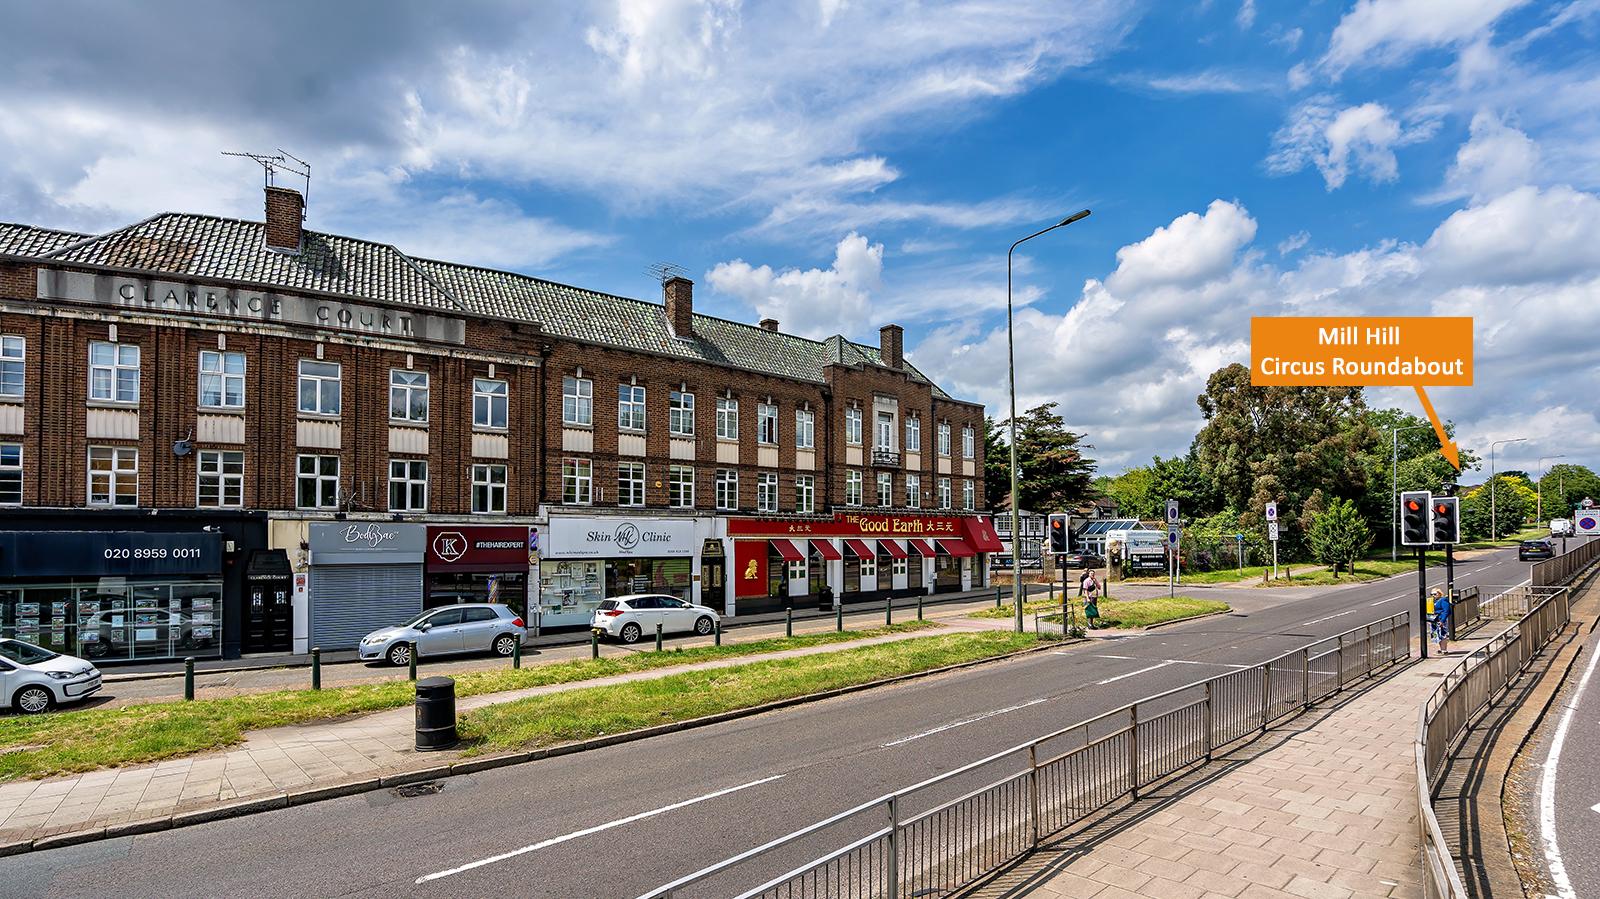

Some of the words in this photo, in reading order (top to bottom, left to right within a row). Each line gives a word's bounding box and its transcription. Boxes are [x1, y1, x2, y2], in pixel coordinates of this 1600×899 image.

[119, 284, 280, 315] CLARENCE
[317, 306, 412, 332] COURT
[846, 515, 860, 524] THE
[859, 517, 889, 533] Good
[892, 518, 924, 533] Earth
[926, 521, 954, 531] 大三元
[586, 531, 611, 542] Skin
[641, 531, 672, 542] Clinic
[441, 538, 459, 555] K
[475, 541, 524, 549] #THEHAIREXPERT
[104, 548, 130, 559] 020
[133, 548, 168, 559] 8959
[172, 548, 201, 558] 0011
